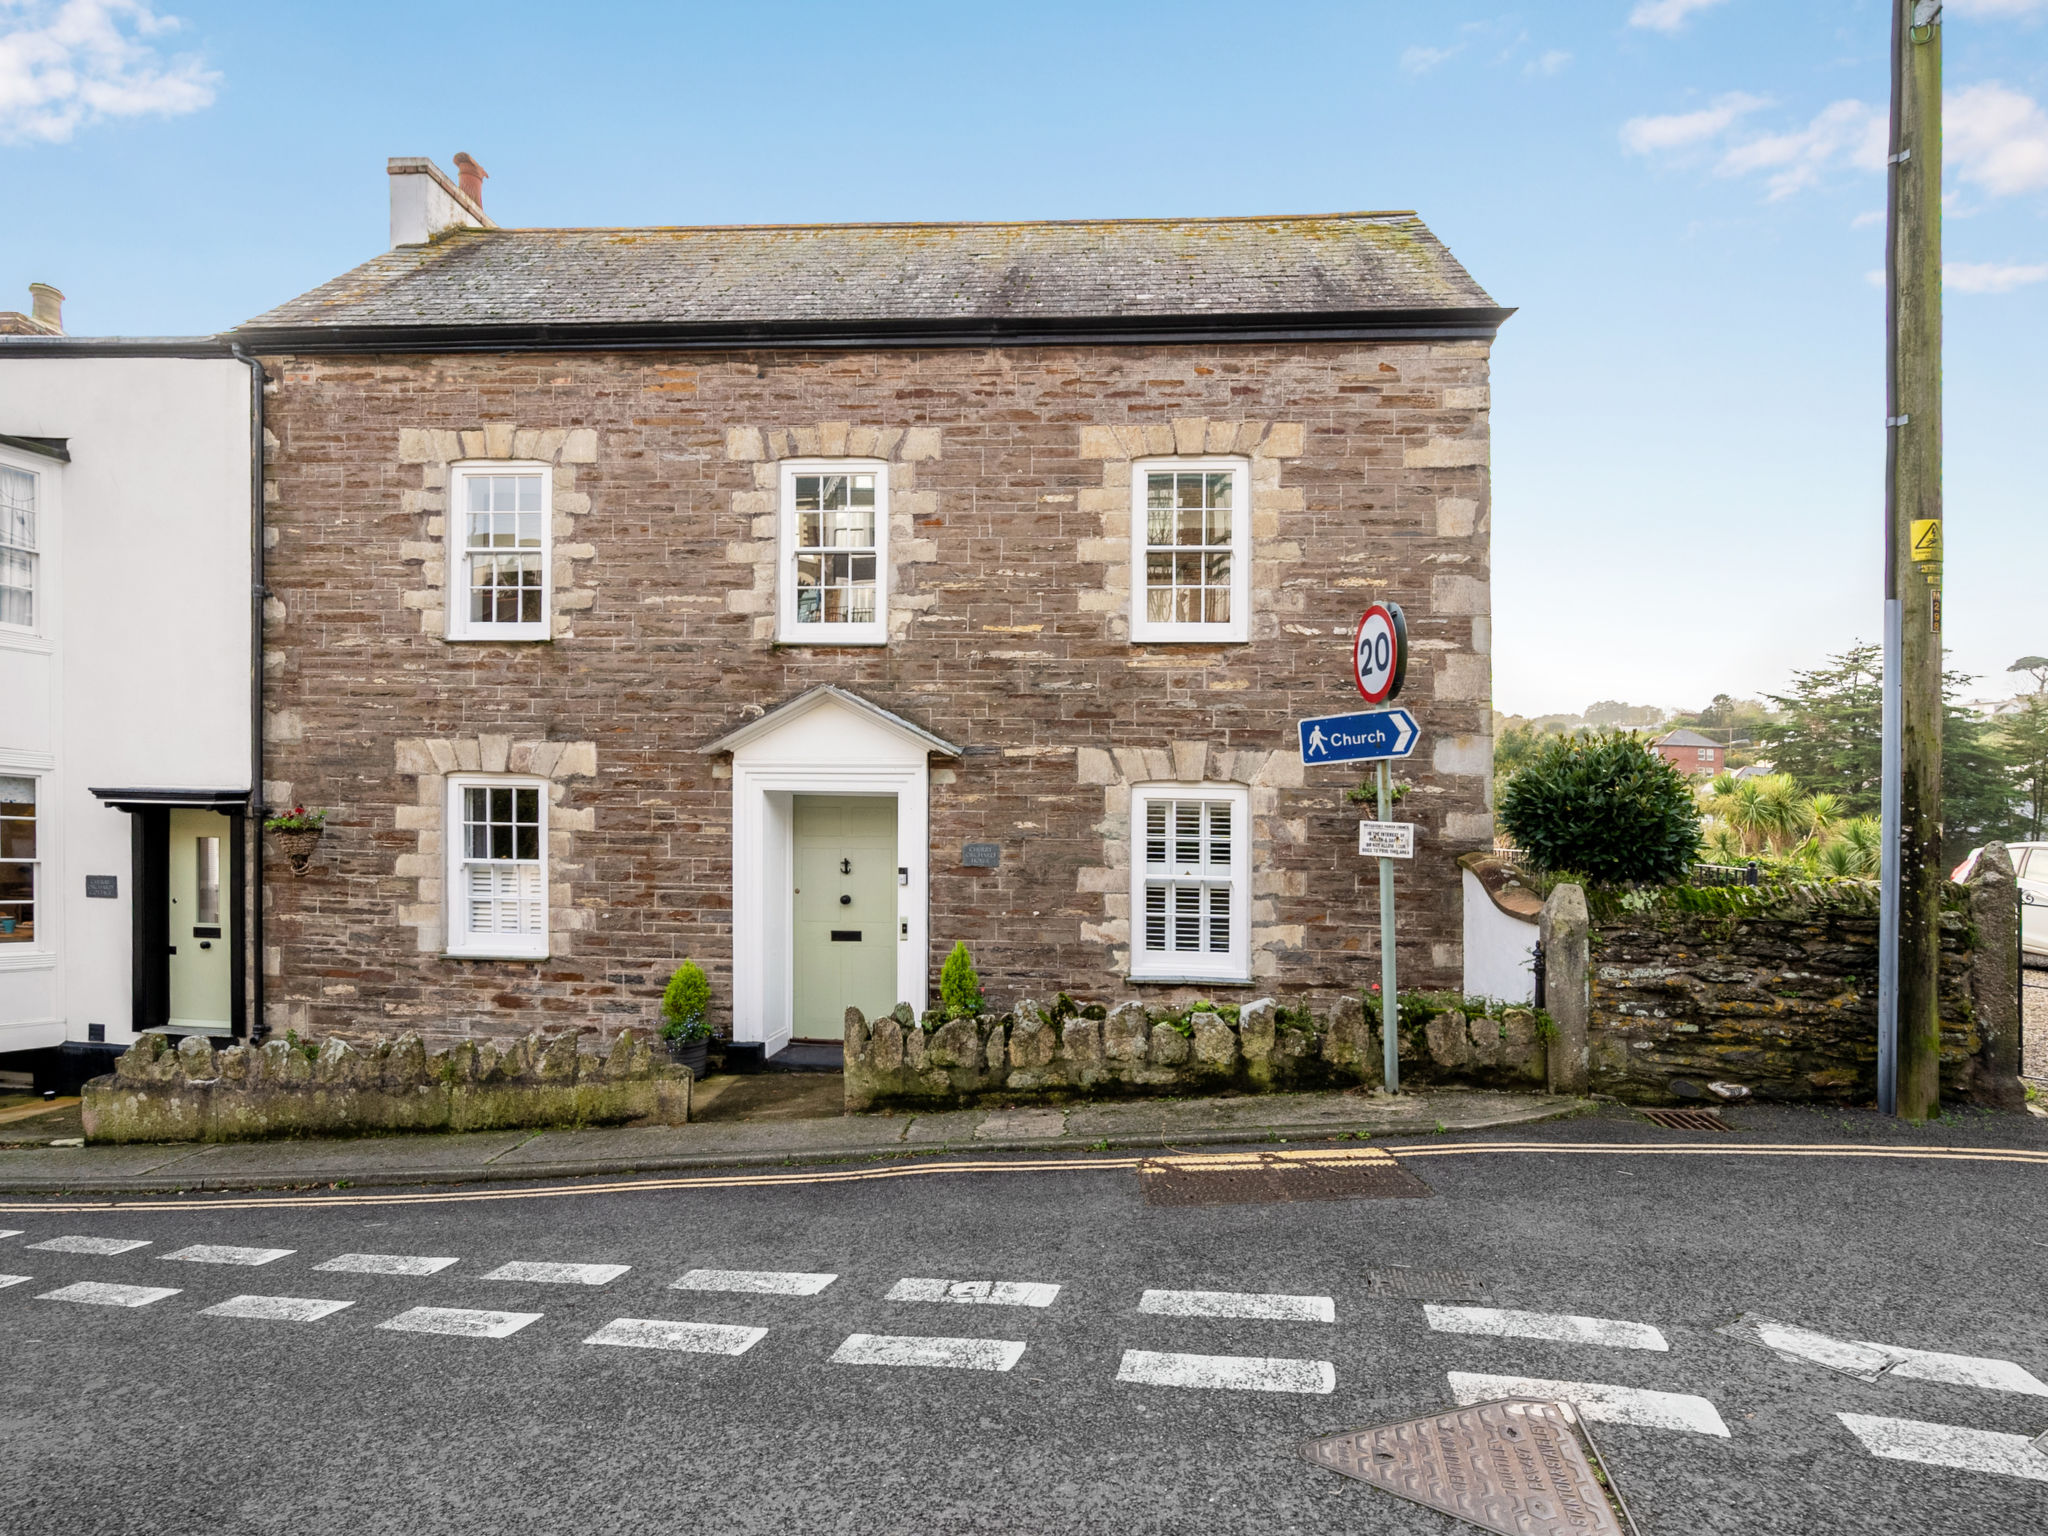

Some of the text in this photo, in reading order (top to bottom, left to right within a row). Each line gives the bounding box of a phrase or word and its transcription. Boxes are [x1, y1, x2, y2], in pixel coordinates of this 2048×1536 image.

[1360, 632, 1390, 677] 20
[1330, 729, 1386, 747] Church
[1488, 1439, 1519, 1490] DUCTILE
